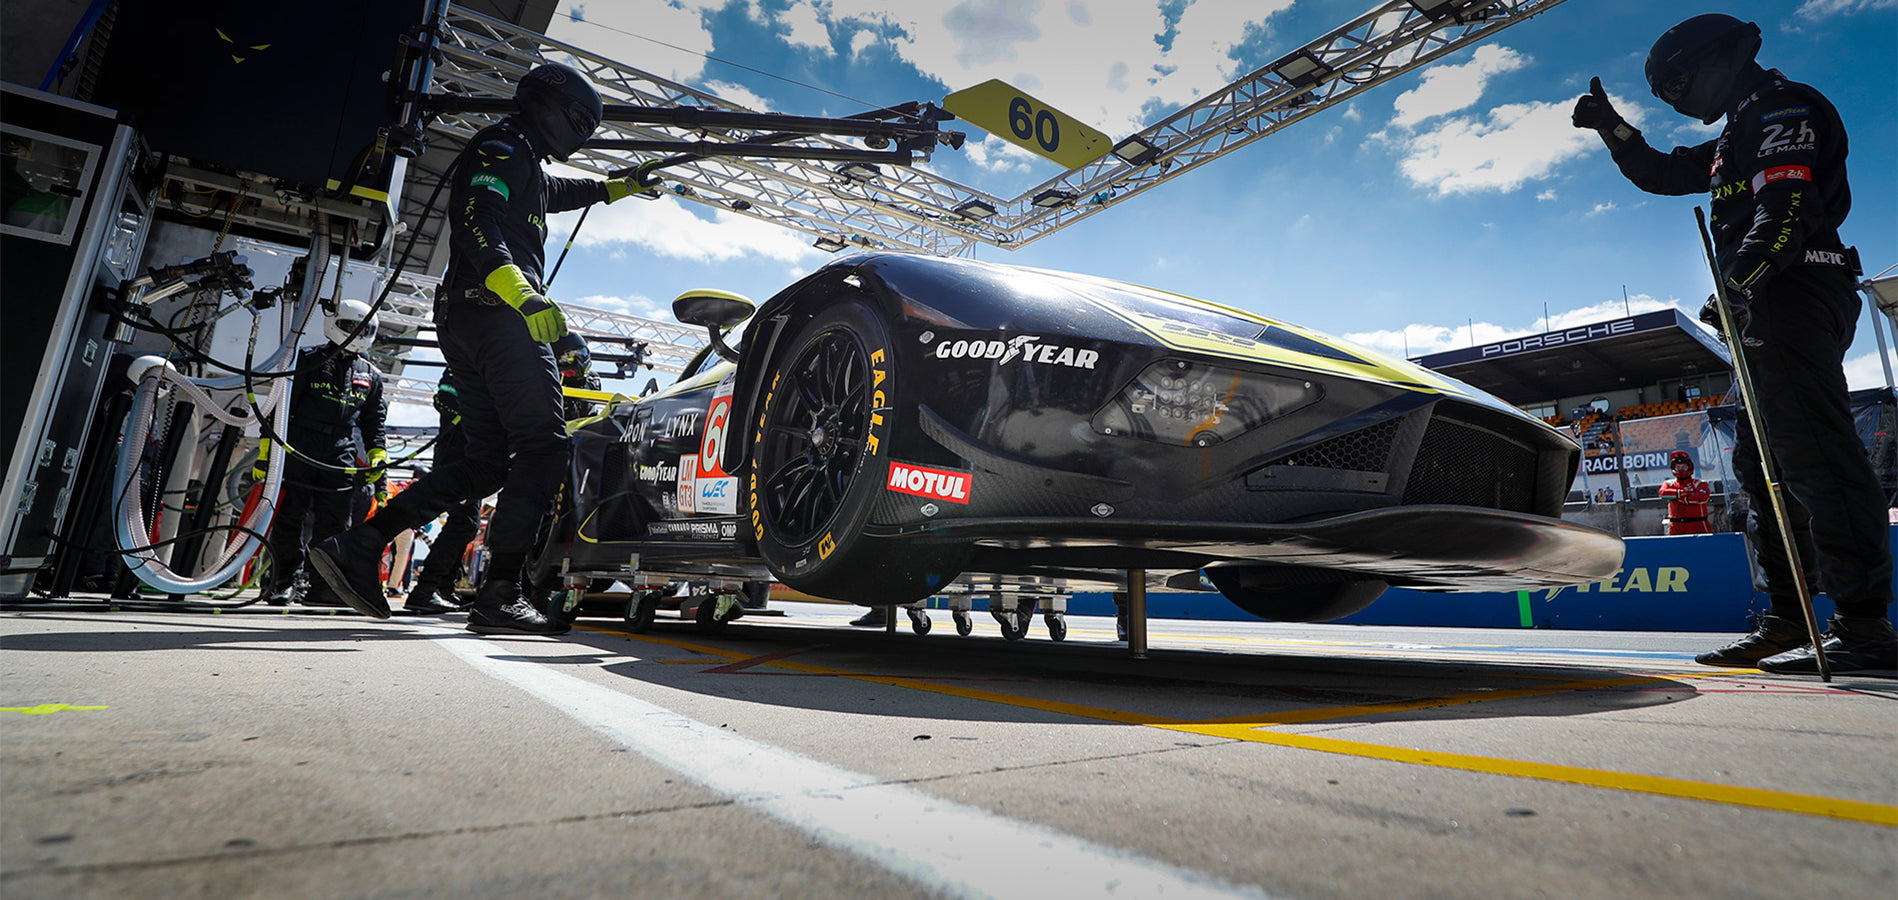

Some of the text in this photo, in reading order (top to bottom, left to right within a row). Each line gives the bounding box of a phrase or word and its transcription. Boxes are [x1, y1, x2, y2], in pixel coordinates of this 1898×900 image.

[1008, 96, 1060, 153] 60
[1757, 143, 1815, 158] LE MANS
[1769, 227, 1793, 253] IRON
[1481, 318, 1636, 358] PORSCHE
[869, 348, 887, 456] EAGLE
[619, 412, 699, 443] IRON LYNX
[681, 459, 694, 482] LM
[889, 466, 966, 499] MOTUL
[679, 484, 693, 509] GT3
[702, 480, 729, 498] WEC
[690, 523, 718, 533] PRISMA
[721, 524, 737, 537] OMP
[1577, 566, 1690, 593] EAR
